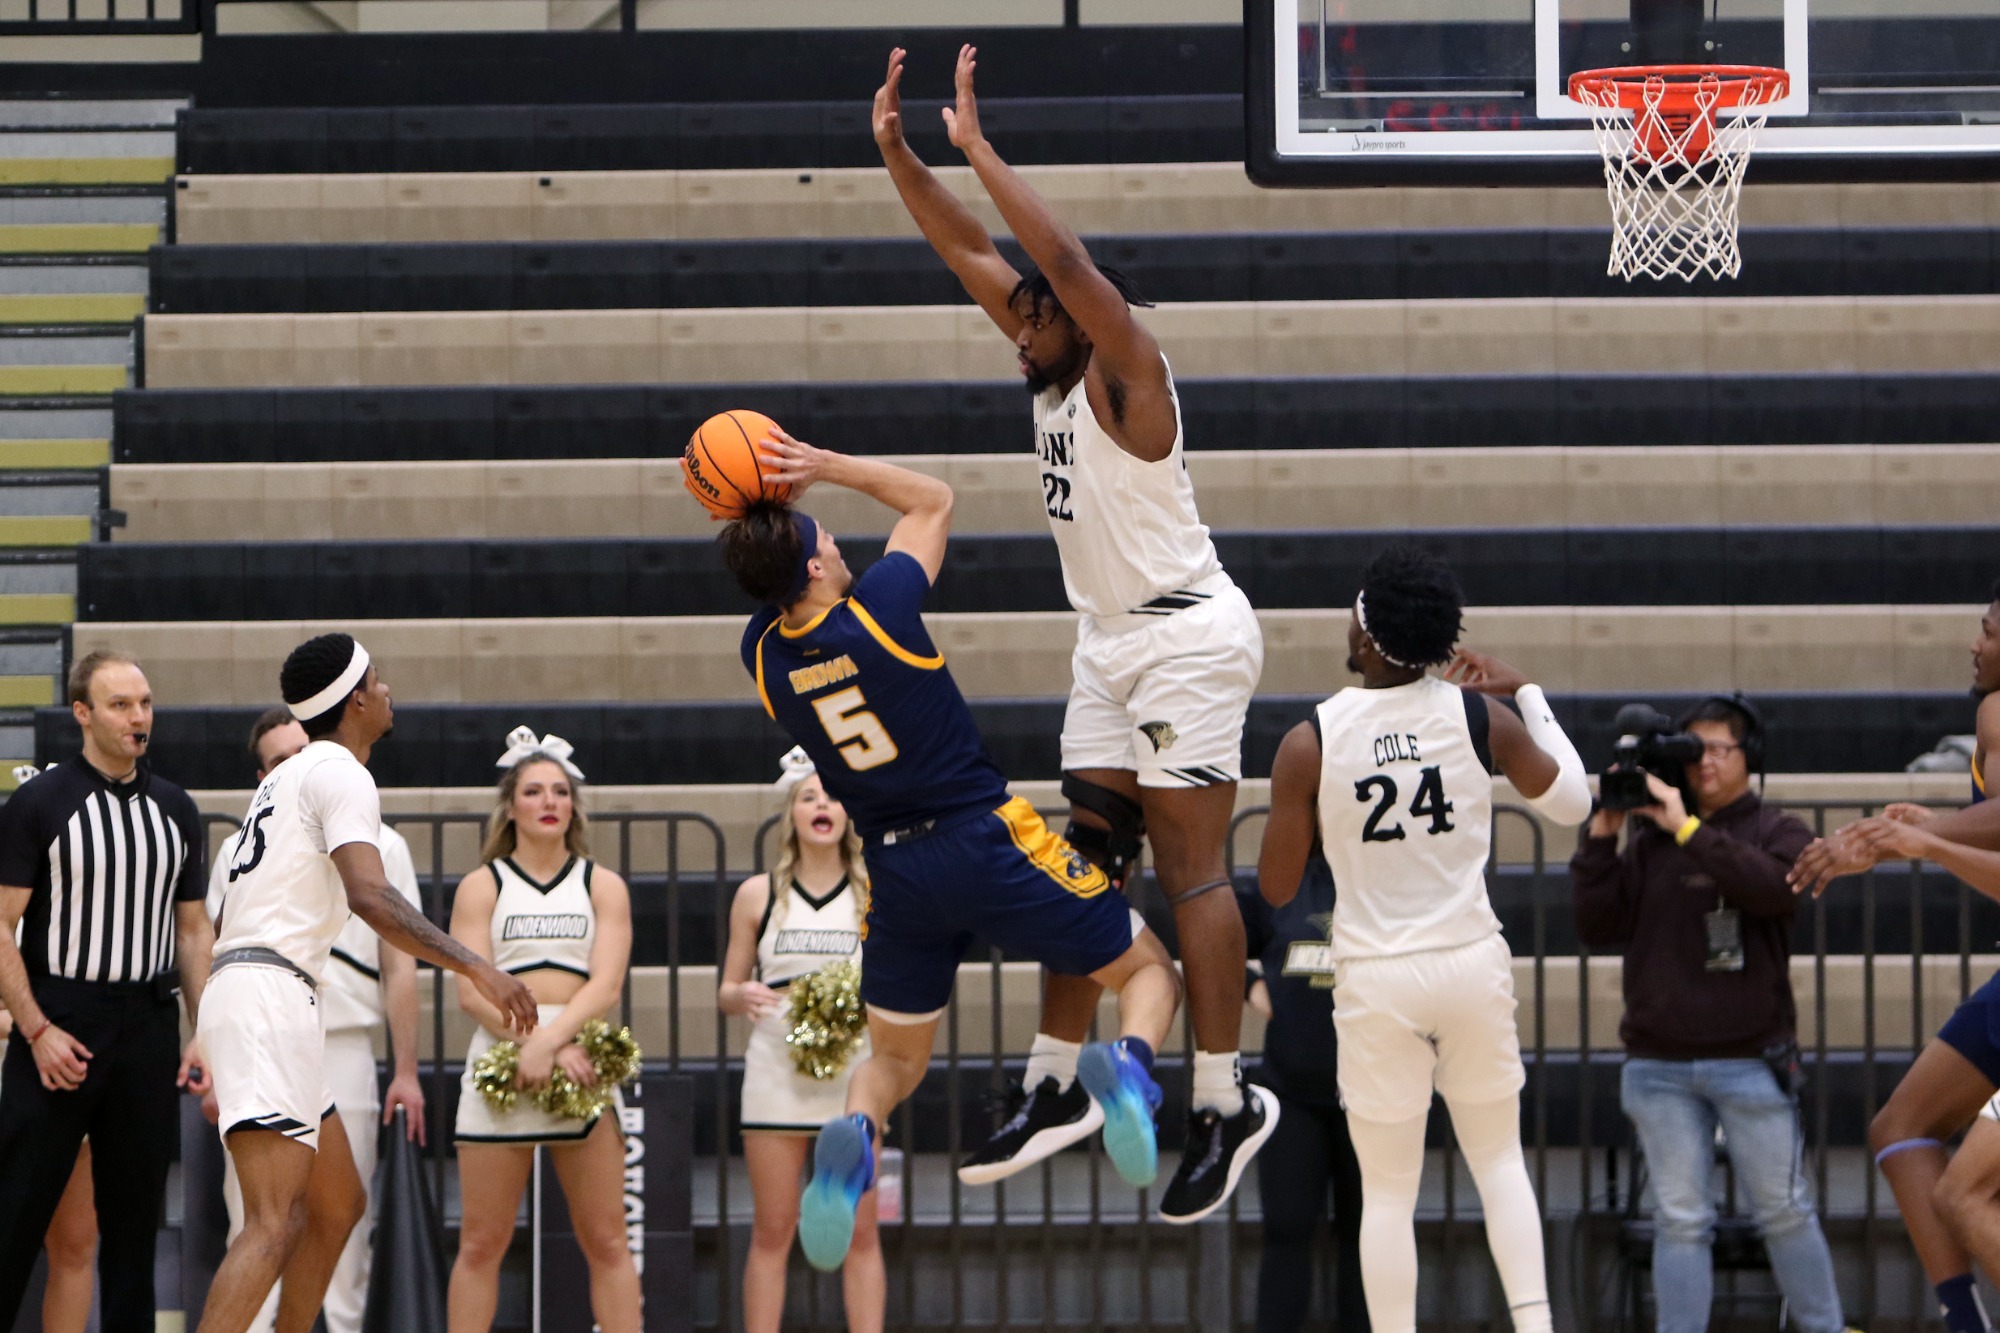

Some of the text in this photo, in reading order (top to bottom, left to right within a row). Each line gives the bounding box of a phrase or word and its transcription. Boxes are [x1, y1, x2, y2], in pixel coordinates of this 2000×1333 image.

[1385, 140, 1406, 151] sports
[1042, 472, 1074, 522] 22
[788, 654, 859, 694] BROWN
[811, 685, 899, 771] 5
[1374, 733, 1421, 767] COLE
[1354, 764, 1455, 842] 24
[503, 914, 588, 940] LINDENWOOD
[774, 928, 859, 955] LINDENWOOD
